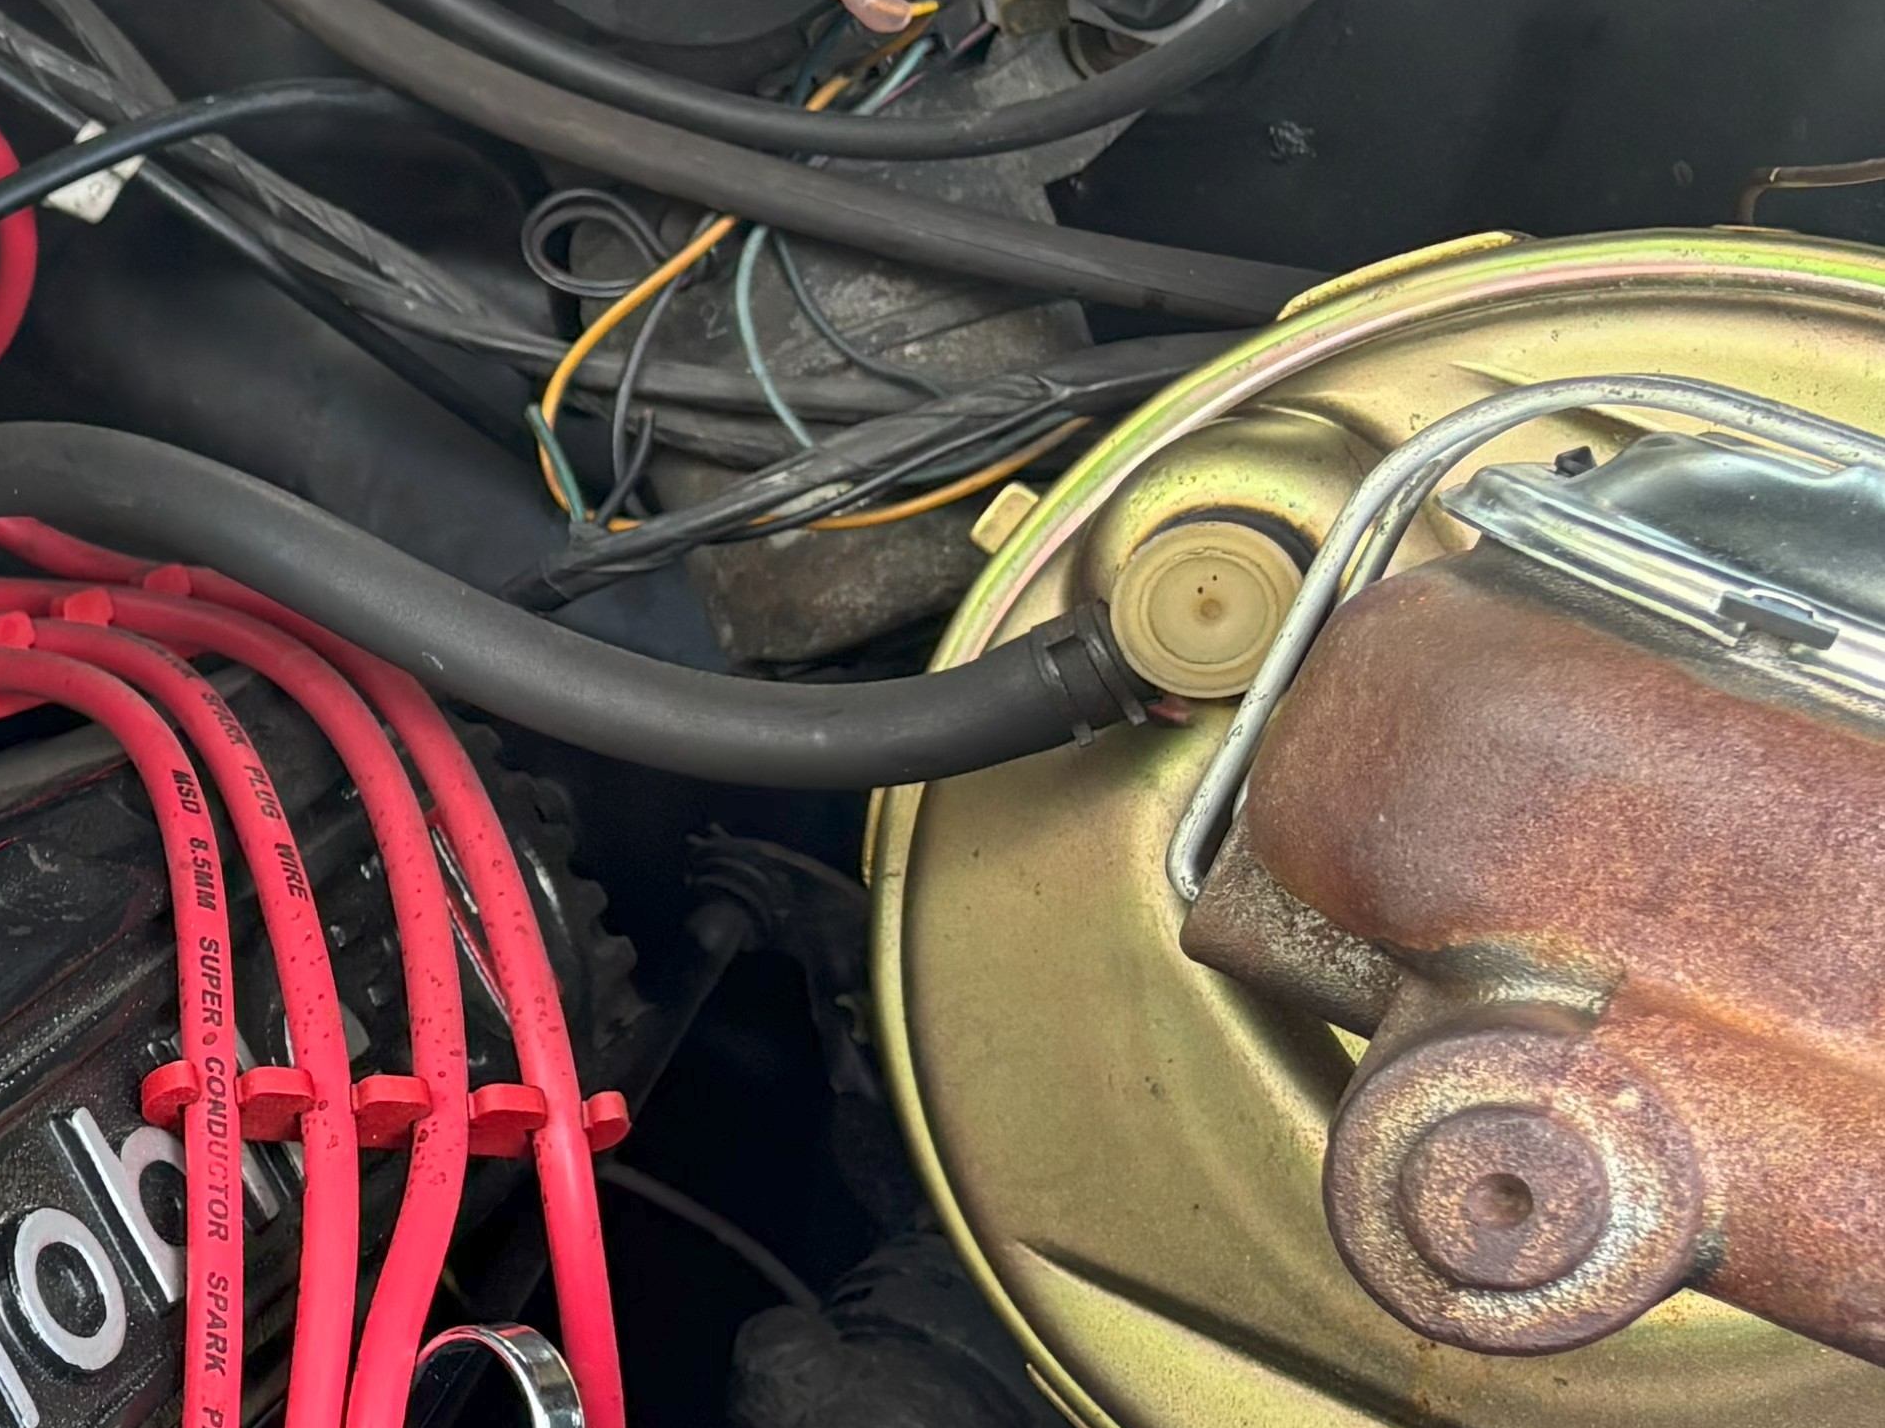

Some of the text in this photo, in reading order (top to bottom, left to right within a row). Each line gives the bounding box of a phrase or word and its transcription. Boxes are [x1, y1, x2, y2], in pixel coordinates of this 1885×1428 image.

[171, 769, 202, 816] MSD
[244, 765, 281, 821] PLUG
[274, 841, 309, 903] WIRE
[187, 836, 219, 913] 8.5MM
[197, 934, 225, 1029] SUPER
[204, 1055, 231, 1242] CONDUCTOR
[205, 1271, 230, 1378] SPARK
